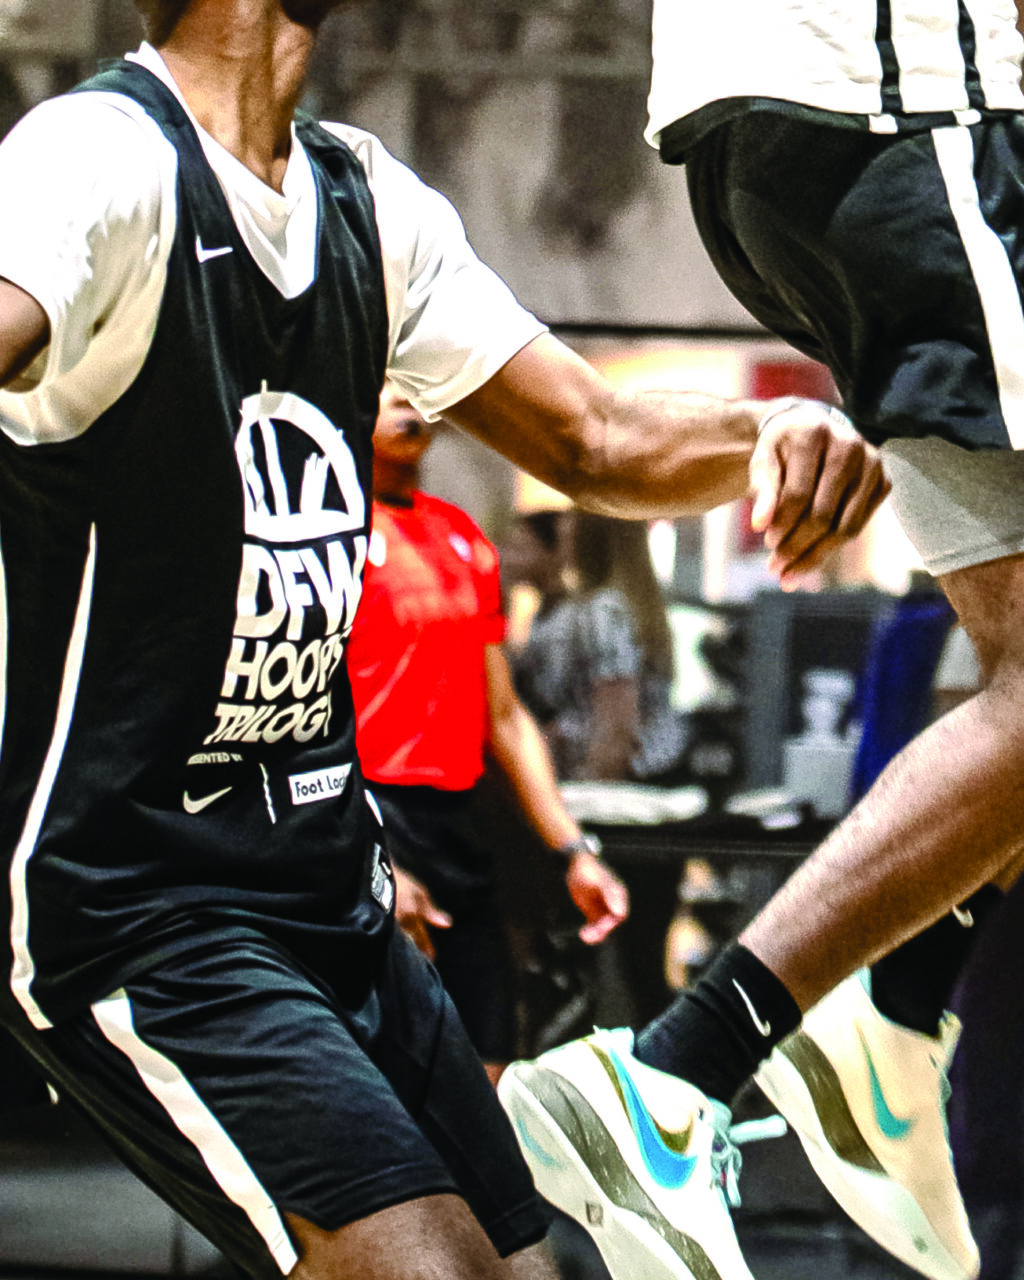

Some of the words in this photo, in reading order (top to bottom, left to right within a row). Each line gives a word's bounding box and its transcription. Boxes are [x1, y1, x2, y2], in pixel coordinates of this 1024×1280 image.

[232, 535, 368, 641] DFW
[203, 691, 333, 745] TRILOG
[295, 778, 324, 798] Foot
